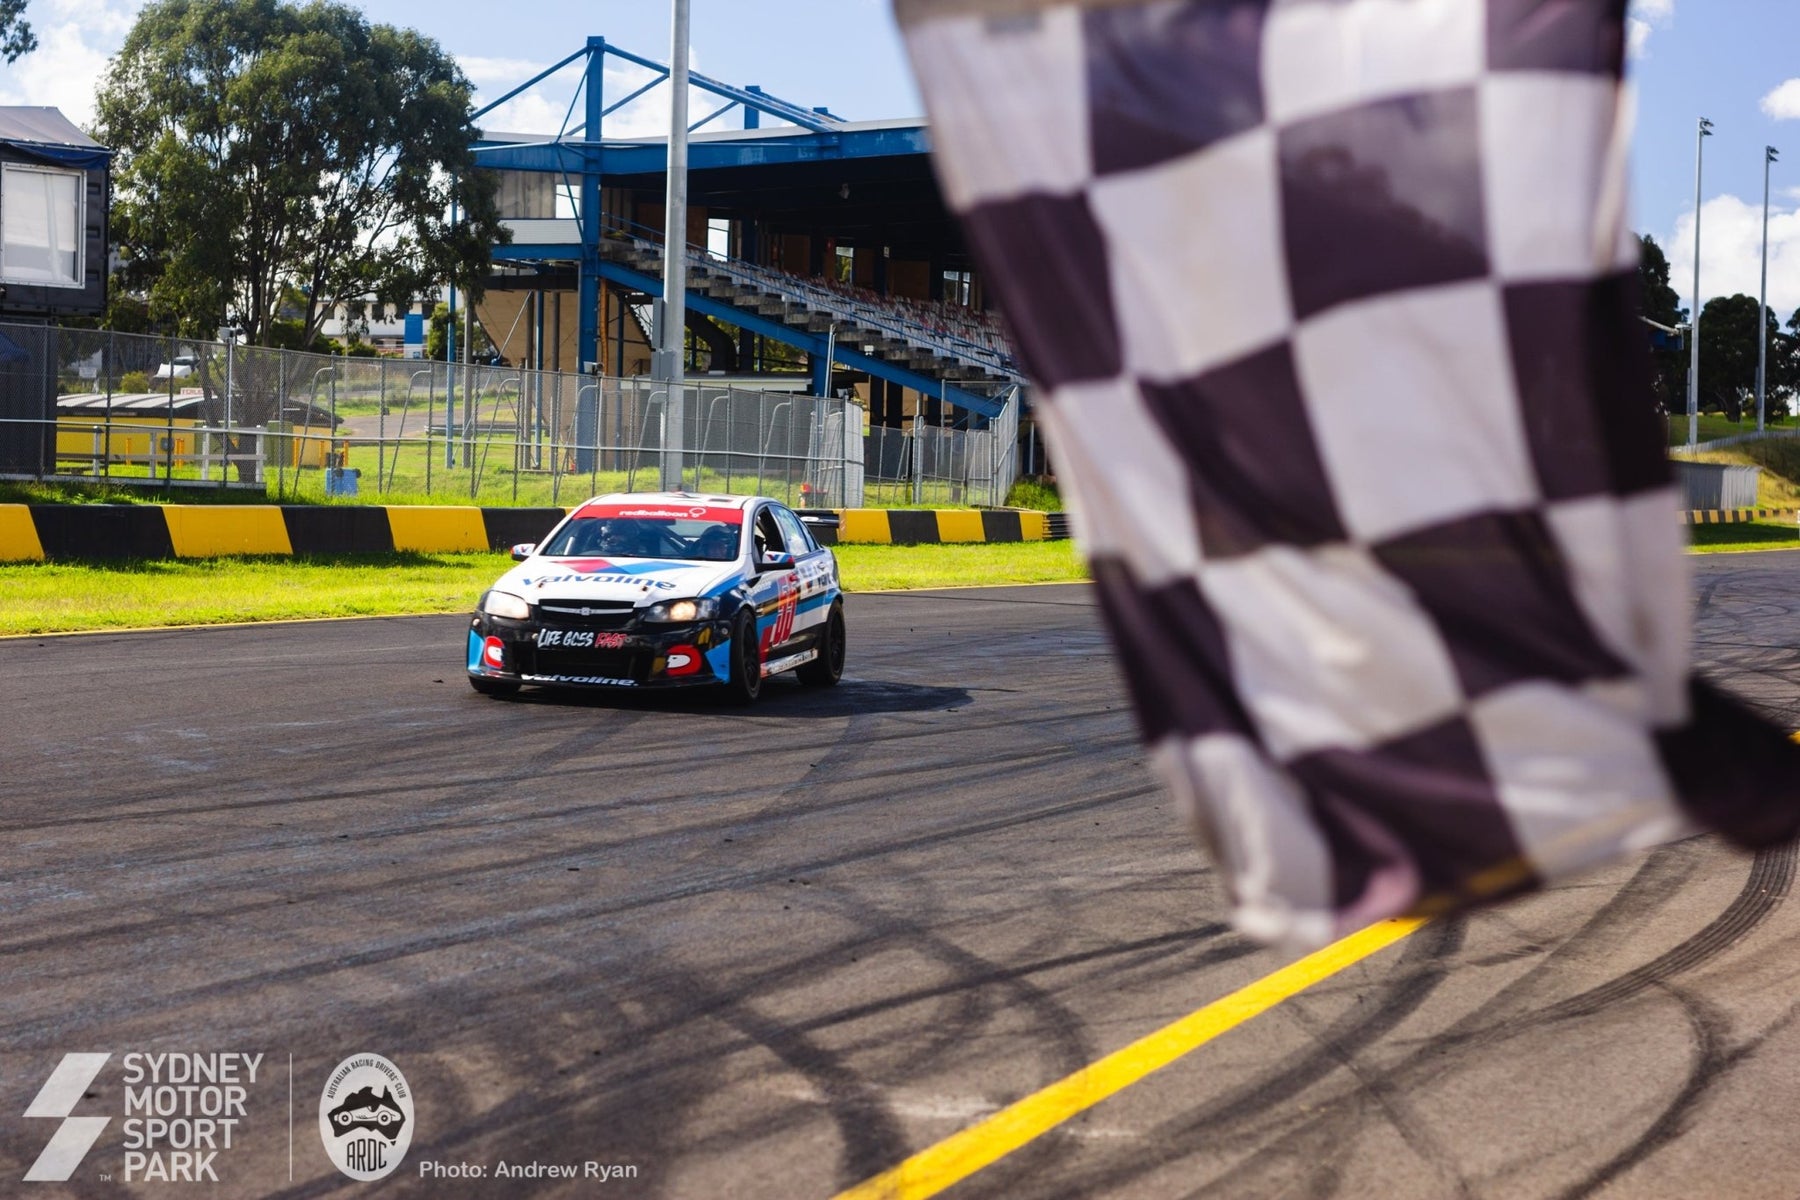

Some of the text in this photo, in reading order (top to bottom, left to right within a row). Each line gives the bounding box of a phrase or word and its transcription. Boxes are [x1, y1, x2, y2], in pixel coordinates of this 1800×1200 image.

[619, 509, 688, 518] redballoon
[537, 628, 627, 649] LIFE GOES FAST
